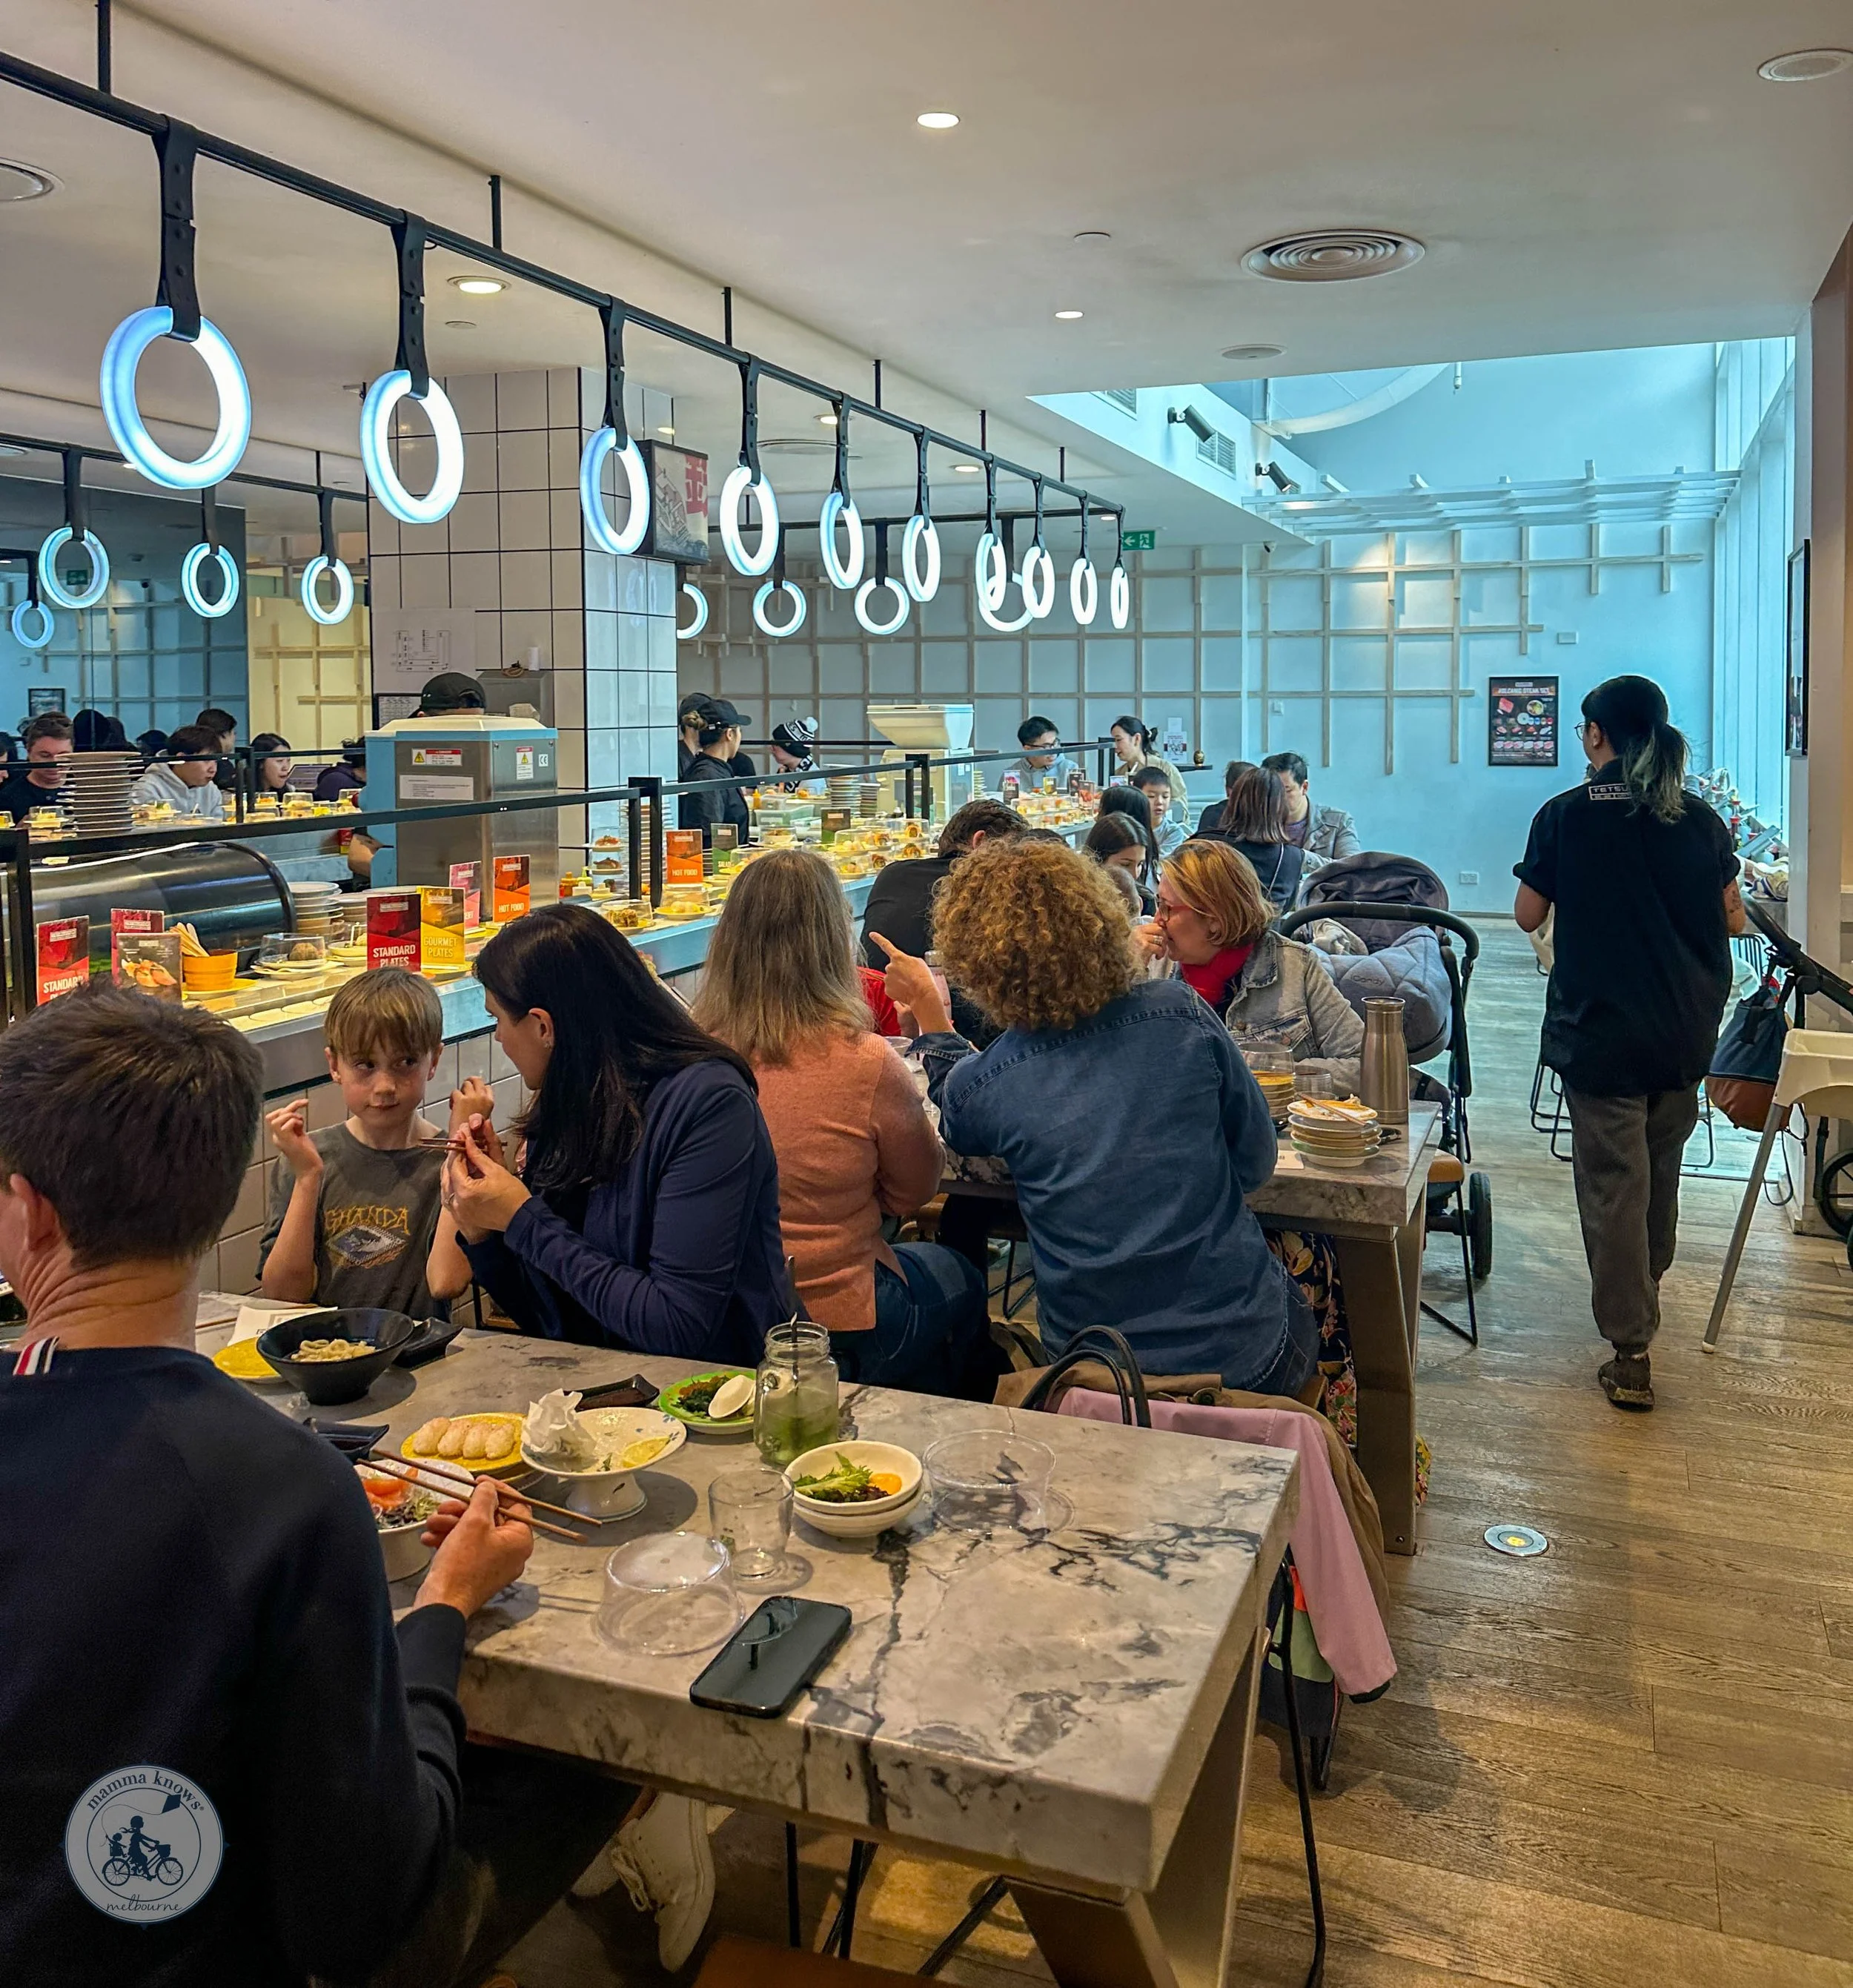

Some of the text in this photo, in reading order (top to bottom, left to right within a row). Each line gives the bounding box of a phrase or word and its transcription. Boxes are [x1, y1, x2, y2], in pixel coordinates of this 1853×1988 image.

[498, 903, 525, 913] HOT FOOD
[424, 936, 458, 947] GOURMET
[373, 944, 416, 958] STANDARD
[428, 948, 454, 958] PLATES
[379, 956, 410, 967] PLATES
